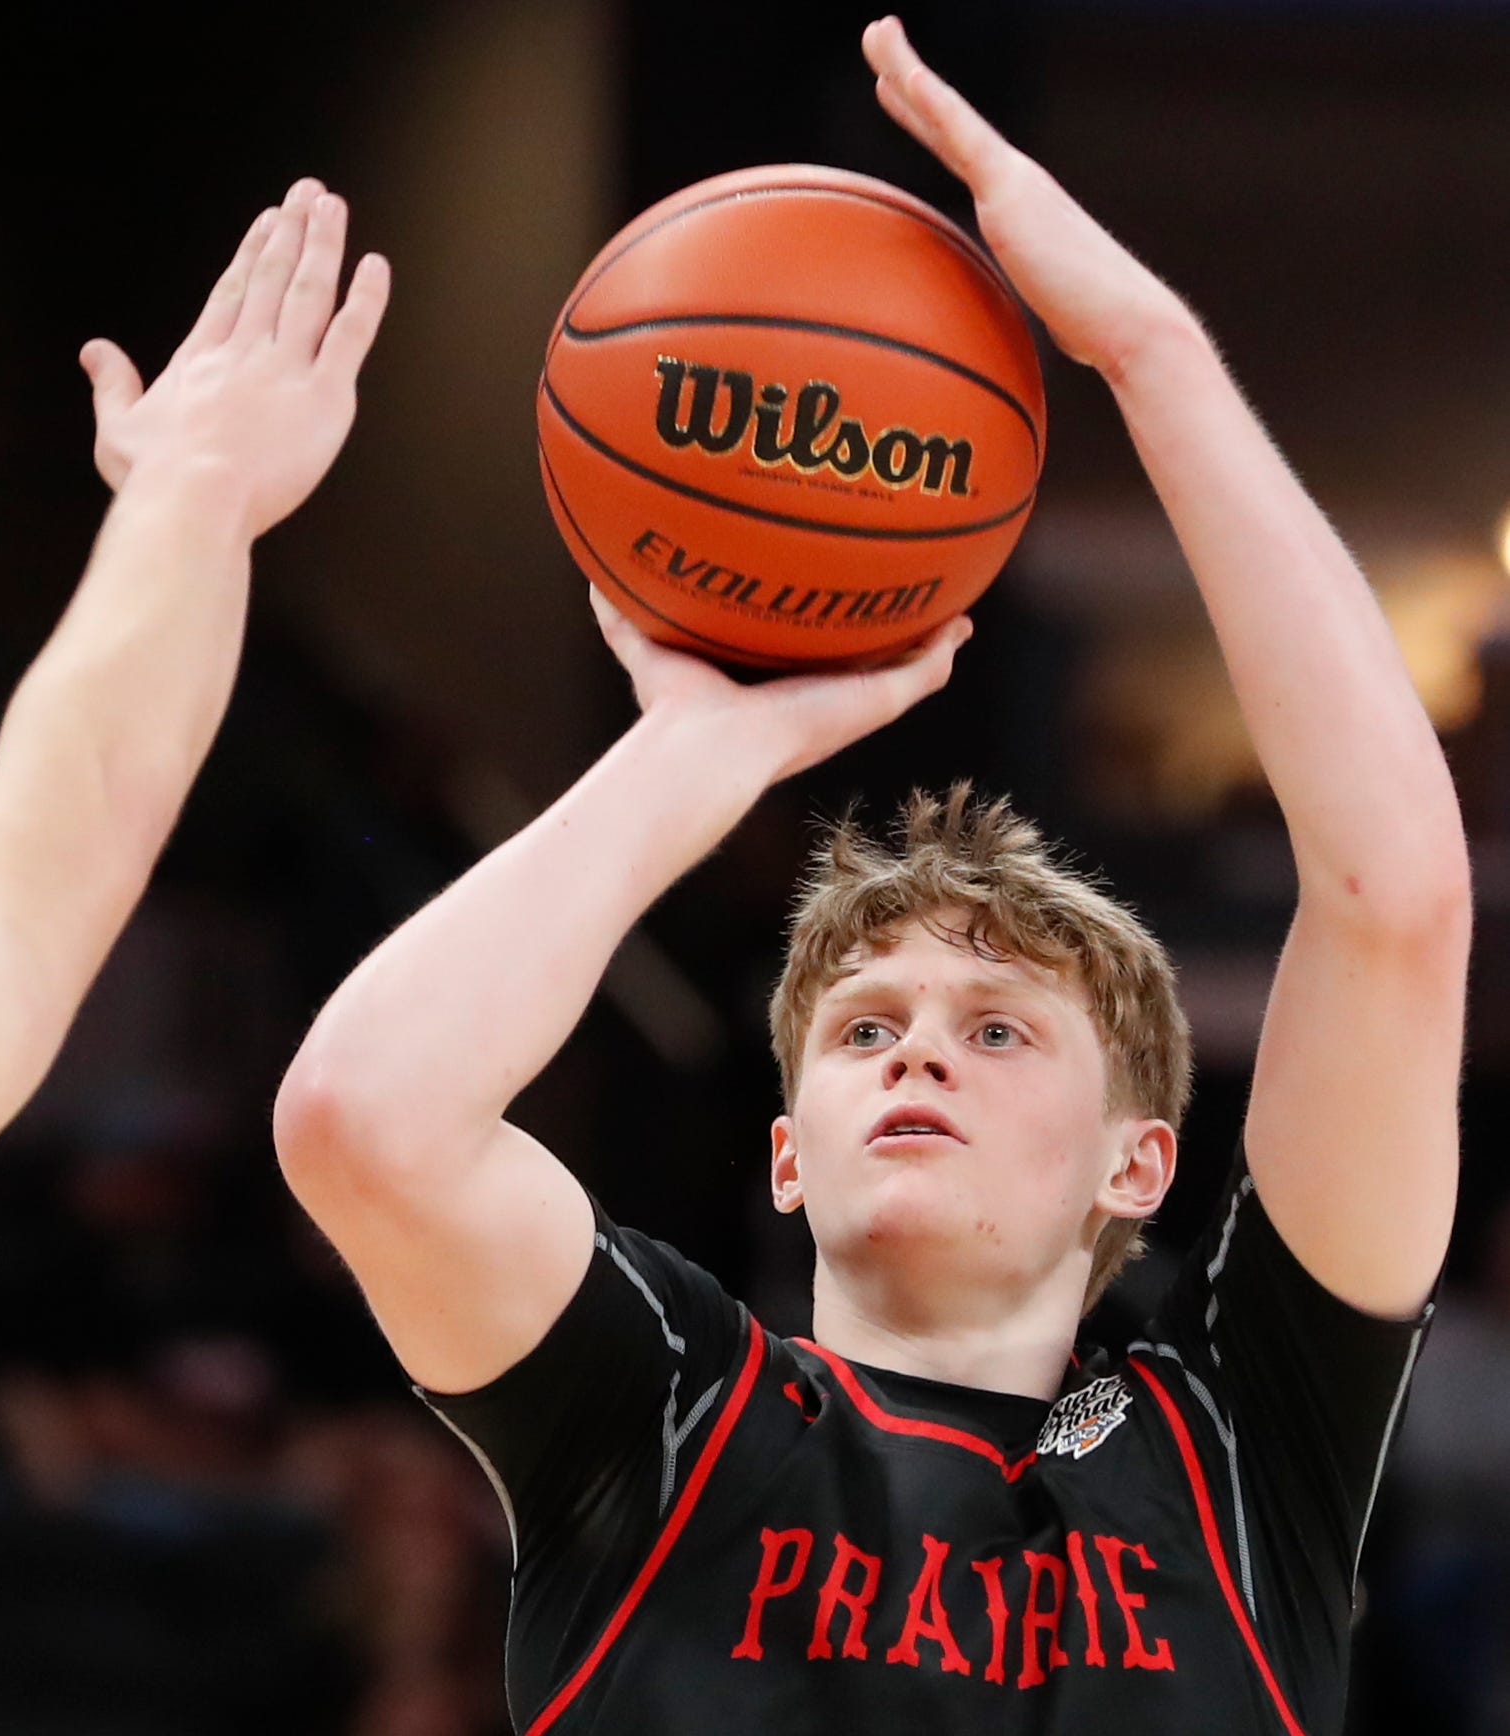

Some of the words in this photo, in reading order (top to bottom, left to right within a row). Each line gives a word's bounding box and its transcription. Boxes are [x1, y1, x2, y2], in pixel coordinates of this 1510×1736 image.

[654, 354, 974, 497] Wilson
[630, 528, 944, 619] EVOLUTION
[730, 1526, 1176, 1690] PRAIRIE
